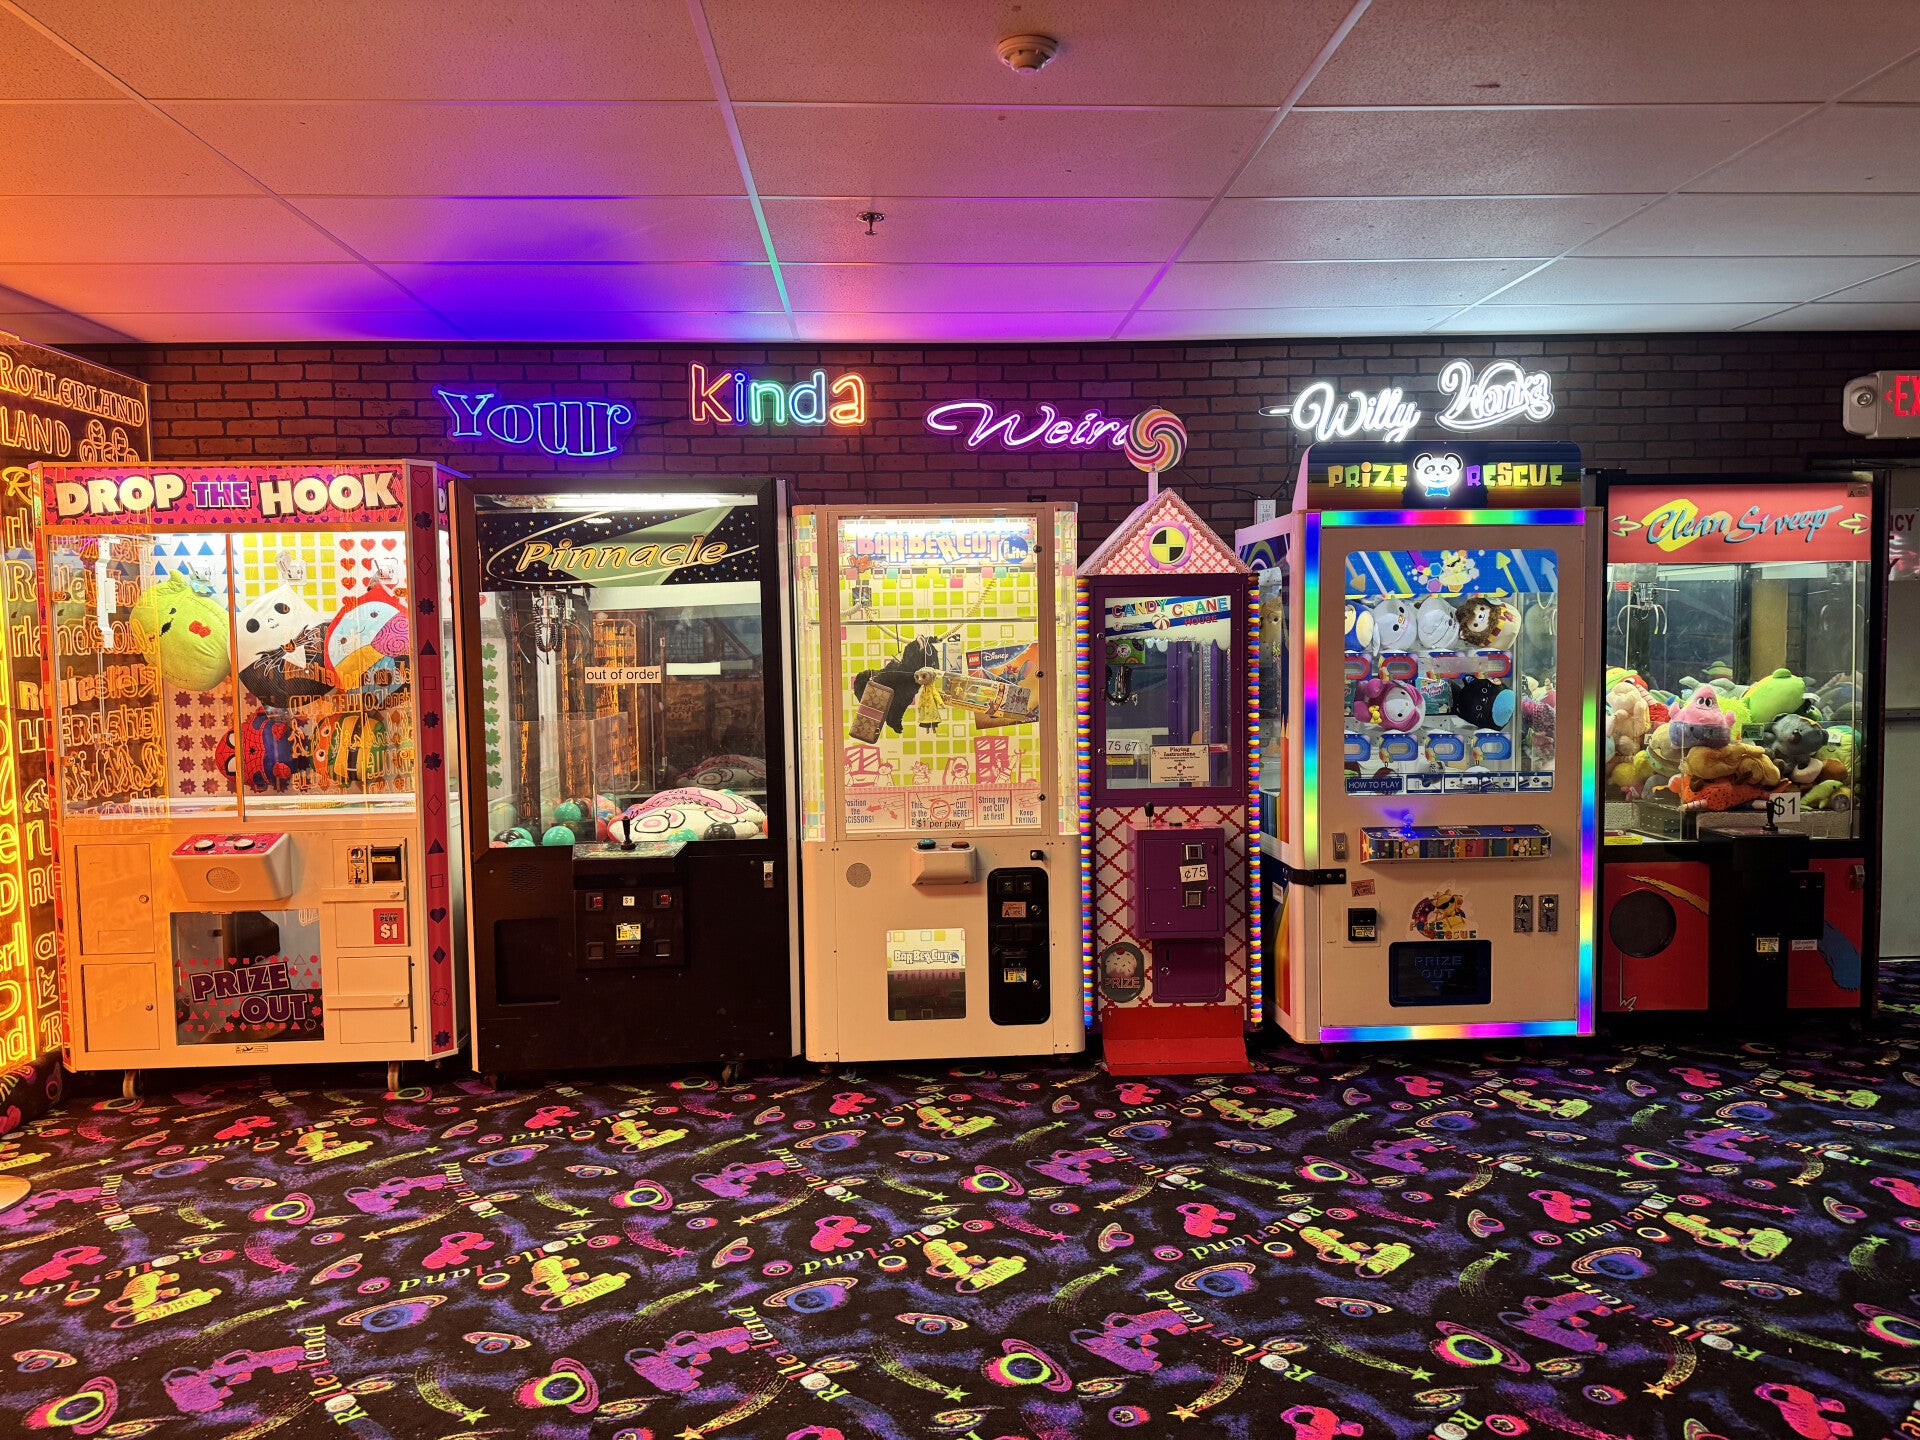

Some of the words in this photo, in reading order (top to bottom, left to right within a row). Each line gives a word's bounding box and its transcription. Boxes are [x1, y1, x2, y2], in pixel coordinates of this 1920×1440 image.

[1269, 382, 1421, 442] Willy
[437, 389, 633, 456] Your
[1466, 463, 1563, 487] RESCUE
[55, 472, 187, 520] DROP
[192, 481, 251, 508] THE
[258, 470, 403, 518] HOOK
[1647, 507, 1726, 544] Clean
[1724, 505, 1844, 544] Sweep
[516, 535, 728, 573] Pinnacle
[1112, 598, 1168, 618] CANDY
[1172, 597, 1229, 617] CRANE
[1184, 615, 1218, 626] HOUSE
[983, 651, 1009, 661] Disney
[586, 669, 607, 681] out
[610, 669, 623, 681] of
[627, 669, 660, 681] order
[1107, 741, 1121, 751] 75
[1368, 781, 1379, 789] TO
[1380, 780, 1401, 788] PLAY
[911, 801, 923, 809] This
[955, 801, 967, 809] CUT
[978, 796, 997, 805] String
[998, 797, 1010, 805] may
[1774, 796, 1797, 816] $1
[918, 809, 928, 817] the
[994, 804, 1006, 812] CUT
[953, 810, 970, 818] HERE!
[1019, 810, 1034, 818] Keep
[916, 820, 927, 828] $1
[929, 821, 943, 829] per
[944, 820, 962, 829] play
[1015, 816, 1038, 824] TRYING!
[1184, 866, 1207, 879] ¢75
[380, 923, 398, 939] $1
[1415, 956, 1462, 966] PRIZE
[1421, 969, 1456, 979] OUT
[190, 962, 290, 1002] PRIZE
[1102, 977, 1142, 989] PRIZE
[240, 994, 308, 1024] OUT
